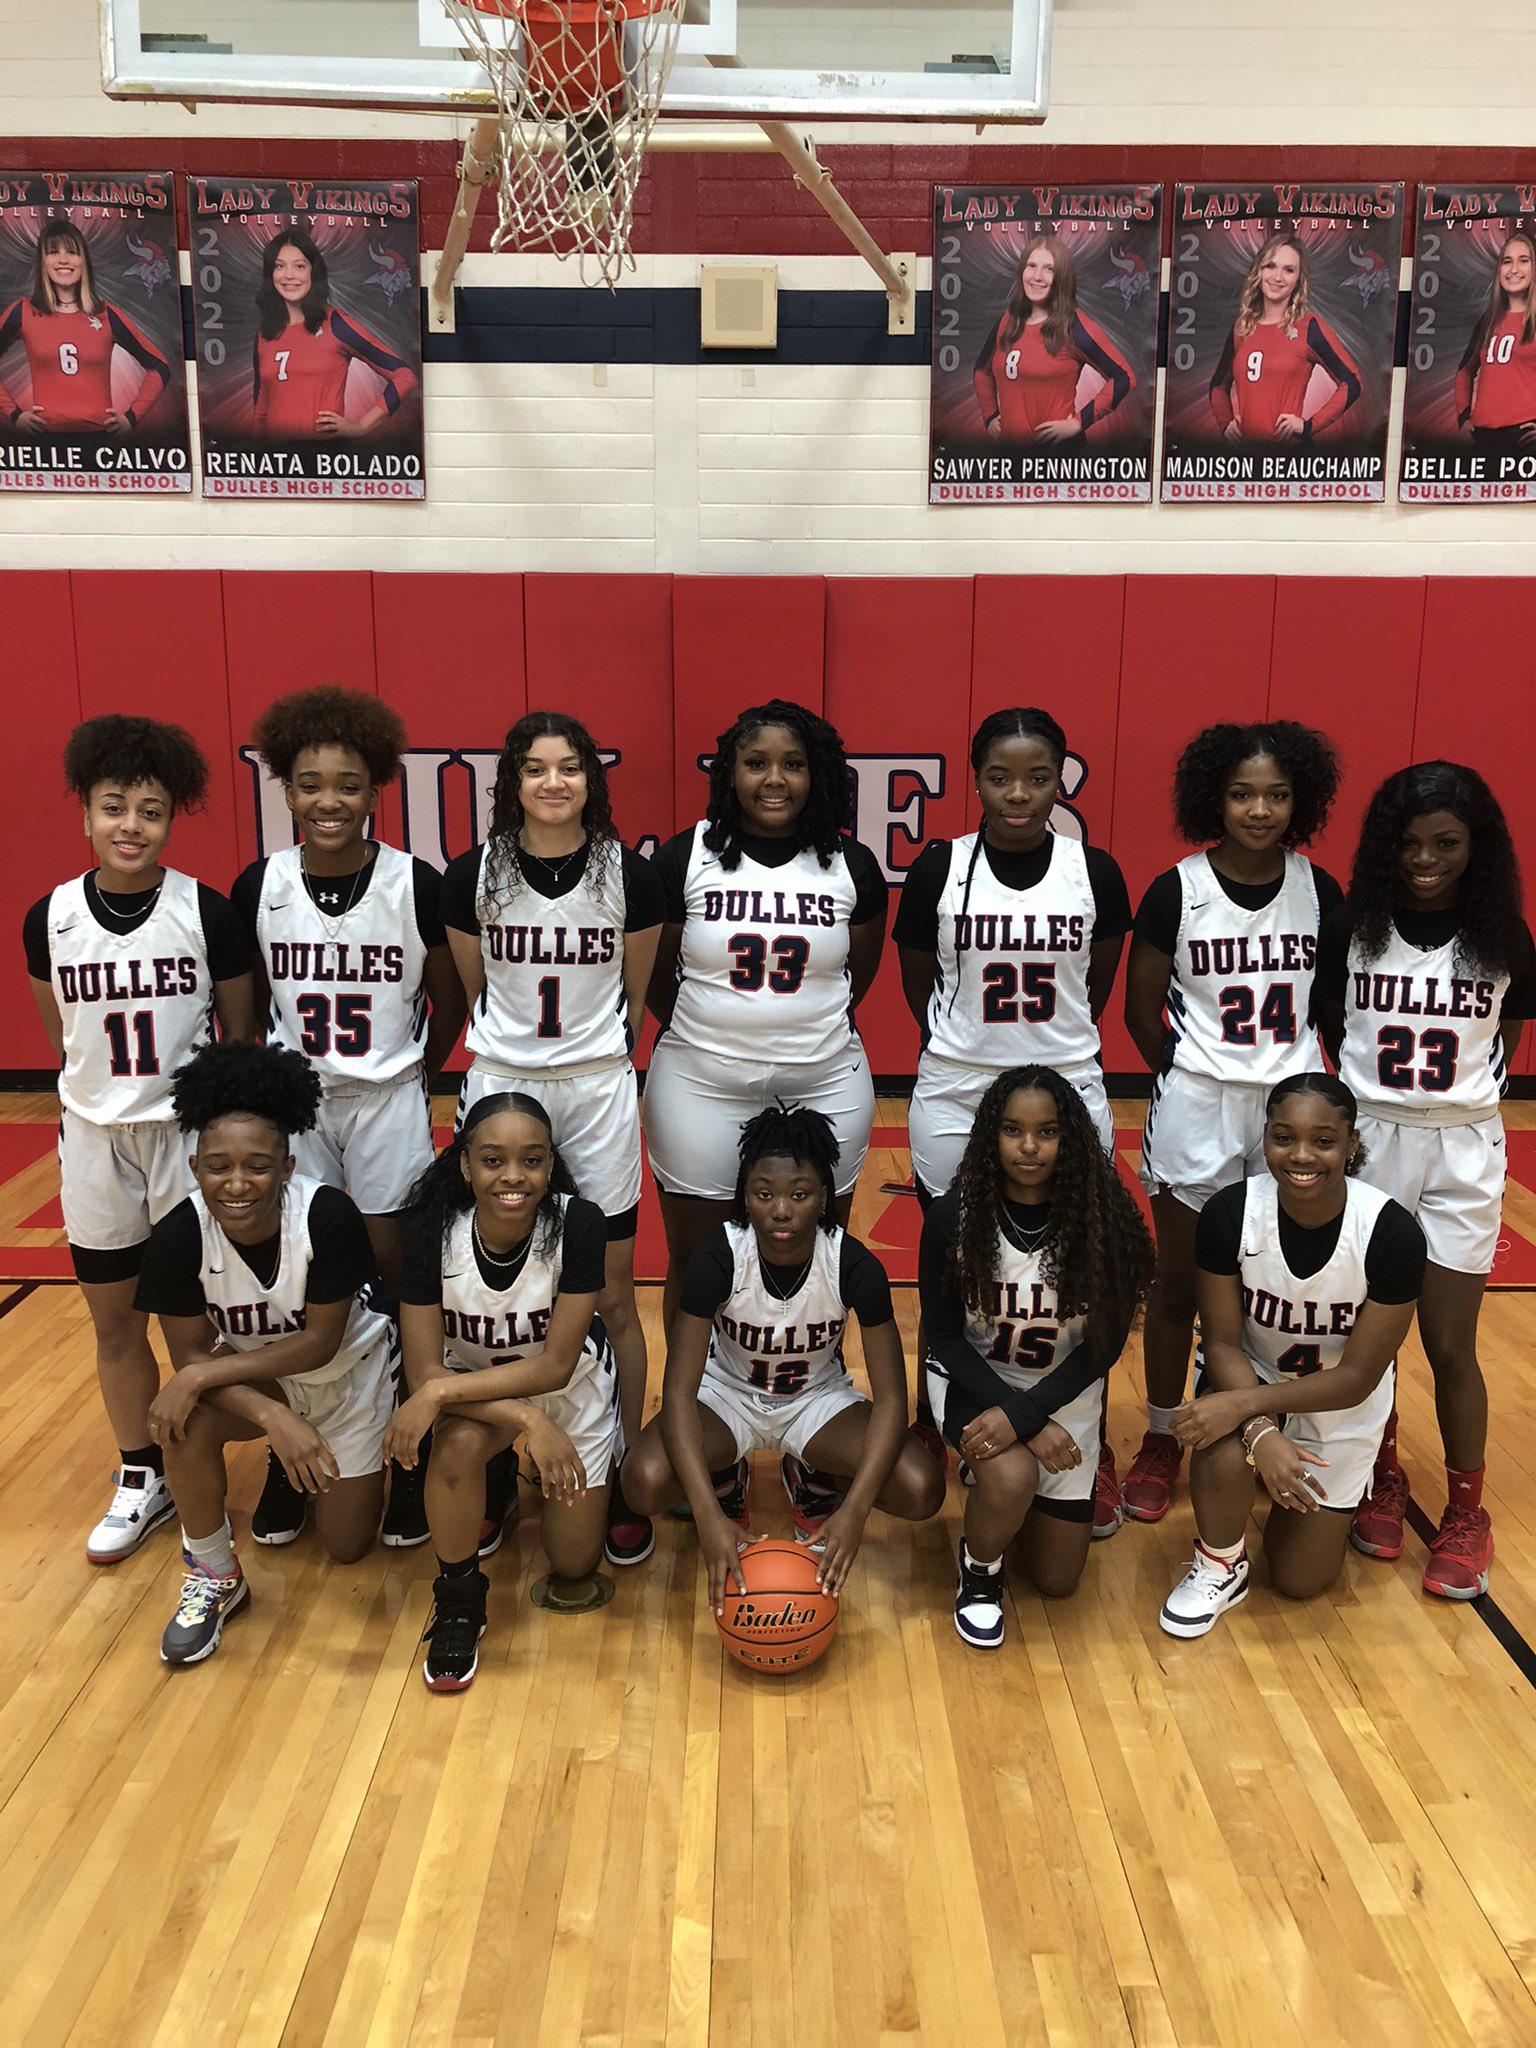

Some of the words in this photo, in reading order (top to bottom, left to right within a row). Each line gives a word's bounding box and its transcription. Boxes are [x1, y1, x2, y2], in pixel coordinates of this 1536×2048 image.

[42, 173, 167, 210] VIKINGS
[197, 179, 276, 214] LADY
[287, 182, 411, 218] VIKINGS
[942, 188, 1020, 223] LADY
[1033, 187, 1154, 221] VIKINGS
[1182, 185, 1262, 220] LADY
[1273, 185, 1395, 220] VIKINGS
[1424, 186, 1503, 220] LADY
[222, 213, 388, 227] VOLLEYBALL
[966, 220, 1130, 232] VOLLEYBALL
[1205, 217, 1370, 230] VOLLEYBALL
[1446, 218, 1536, 230] VOLLE
[198, 227, 226, 366] 2020
[939, 235, 962, 372] 2020
[1174, 234, 1200, 371] 2020
[1414, 234, 1441, 371] 2020
[57, 342, 79, 376] 6
[274, 350, 291, 382] 7
[1005, 350, 1021, 380] 8
[1246, 351, 1264, 382] 9
[1485, 334, 1515, 364] 10
[96, 447, 187, 470] CALVO
[206, 452, 304, 475] RENATA
[316, 453, 420, 477] BOLADO
[933, 458, 1012, 480] SAWYER
[1022, 457, 1147, 480] PENNINGTON
[1166, 456, 1254, 479] MADISON
[1262, 456, 1381, 479] BEAUCHAMP
[1404, 457, 1486, 479] BELLE
[1499, 456, 1536, 479] PO
[0, 473, 45, 487] LLES
[53, 474, 99, 488] HIGH
[109, 475, 179, 489] SCHOOL
[213, 479, 279, 494] DULLES
[287, 480, 333, 495] HIGH
[341, 481, 413, 496] SCHOOL
[939, 485, 1004, 499] DULLES
[1013, 485, 1059, 499] HIGH
[1067, 484, 1139, 499] SCHOOL
[1171, 484, 1236, 498] DULLES
[1244, 484, 1290, 498] HIGH
[1299, 484, 1371, 498] SCHOOL
[1408, 485, 1472, 499] DULLES
[1480, 484, 1527, 498] HIGH
[704, 890, 836, 928] DULLES
[485, 924, 615, 966] DULLES
[953, 914, 1084, 952] DULLES
[270, 942, 404, 983] DULLES
[727, 933, 811, 994] 33
[1187, 933, 1317, 977] DULLES
[57, 956, 198, 1004] DULLES
[982, 962, 1057, 1024] 25
[1354, 971, 1495, 1019] DULLES
[296, 993, 372, 1058] 35
[537, 976, 562, 1039] 1
[1218, 982, 1298, 1046] 24
[103, 1009, 160, 1077] 11
[1376, 1024, 1460, 1092] 23
[442, 1307, 551, 1349] DULLE
[1241, 1286, 1363, 1336] DULLE
[985, 1321, 1059, 1369] 15
[1276, 1343, 1323, 1377] 4
[747, 1359, 810, 1395] 12
[732, 1601, 816, 1628] Baden
[739, 1645, 811, 1665] ELITE
